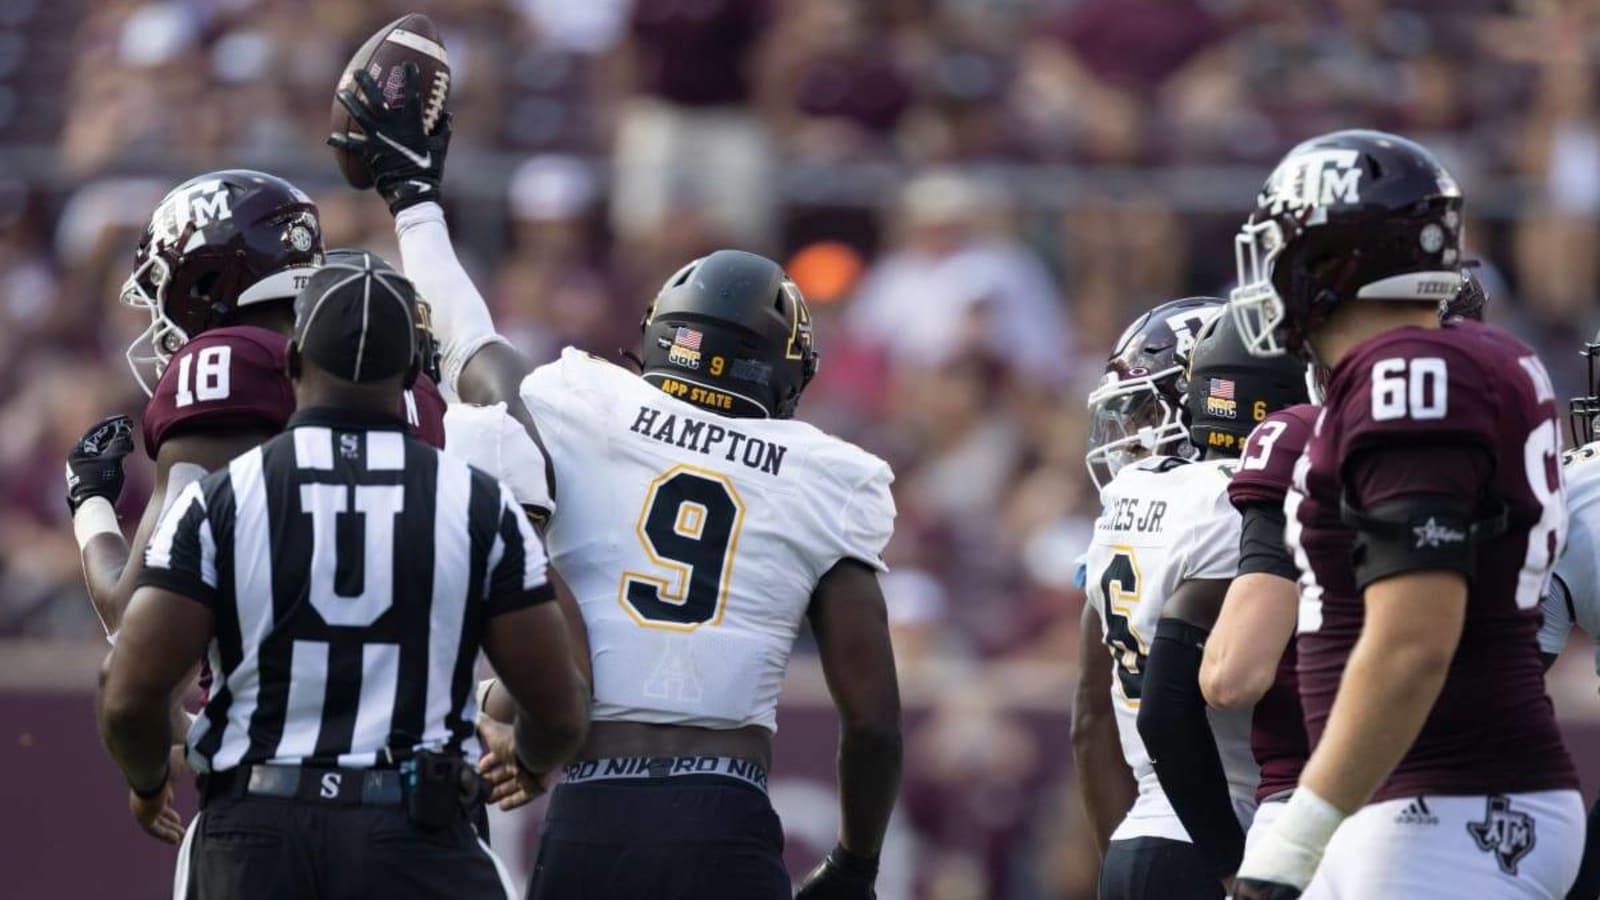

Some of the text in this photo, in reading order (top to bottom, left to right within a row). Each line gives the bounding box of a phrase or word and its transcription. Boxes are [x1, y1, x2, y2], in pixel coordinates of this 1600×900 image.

[669, 344, 701, 370] SBC
[709, 355, 725, 376] 9
[175, 345, 232, 408] 18
[1371, 357, 1449, 421] 60
[661, 379, 734, 409] APP STATE
[1207, 396, 1237, 419] SBC
[1253, 400, 1267, 421] 6
[630, 406, 788, 477] HAMPTON
[1208, 431, 1235, 448] APP
[1137, 500, 1168, 533] JR.
[300, 483, 405, 628] U
[618, 463, 746, 632] 9
[1101, 544, 1150, 709] 6
[320, 773, 342, 799] S
